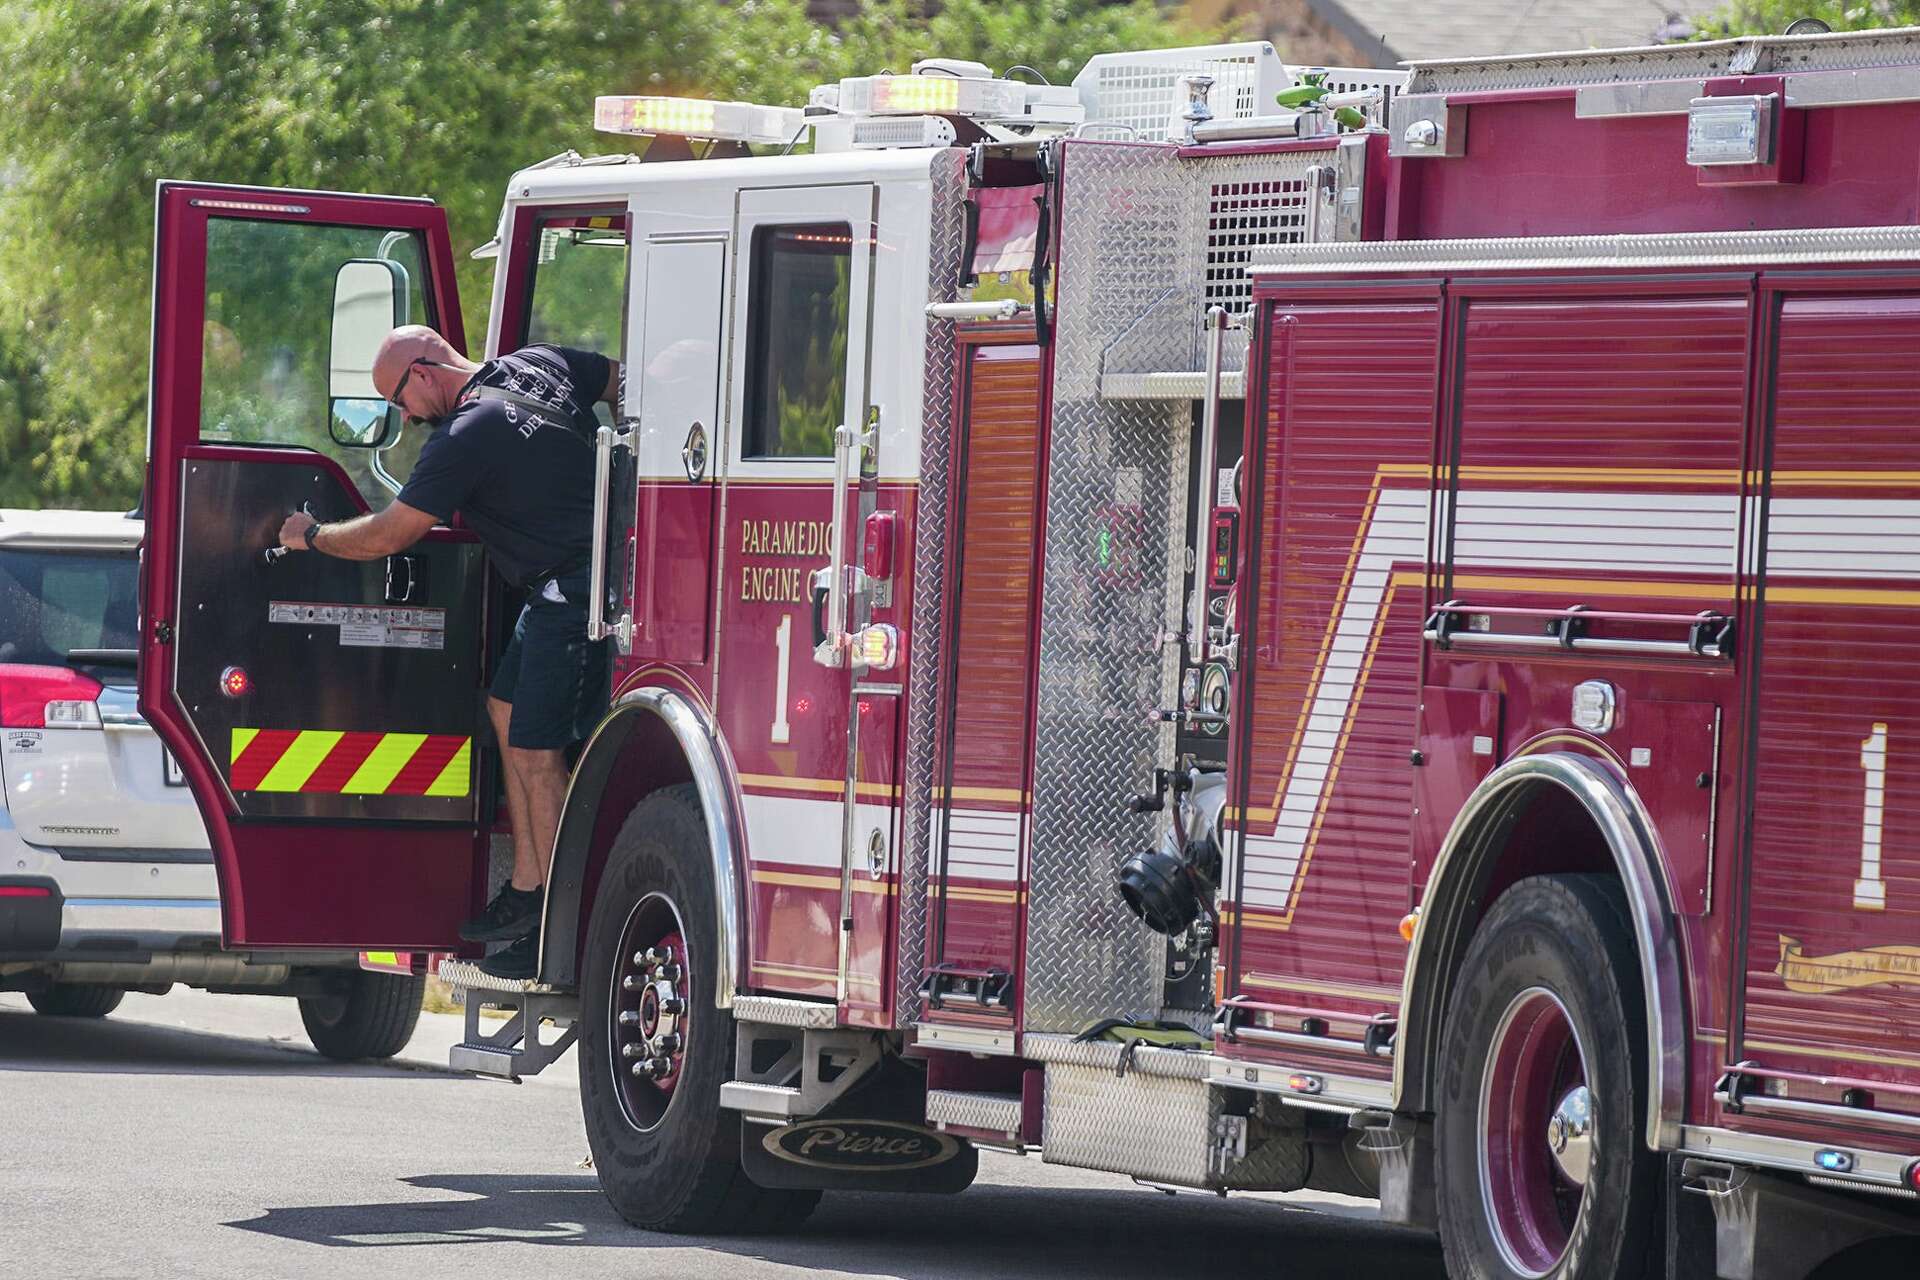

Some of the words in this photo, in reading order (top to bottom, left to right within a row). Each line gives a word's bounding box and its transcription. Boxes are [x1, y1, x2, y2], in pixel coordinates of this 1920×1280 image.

[741, 566, 801, 602] ENGINE
[771, 614, 791, 744] 1
[1853, 722, 1888, 911] 1
[799, 1127, 923, 1155] Pierce
